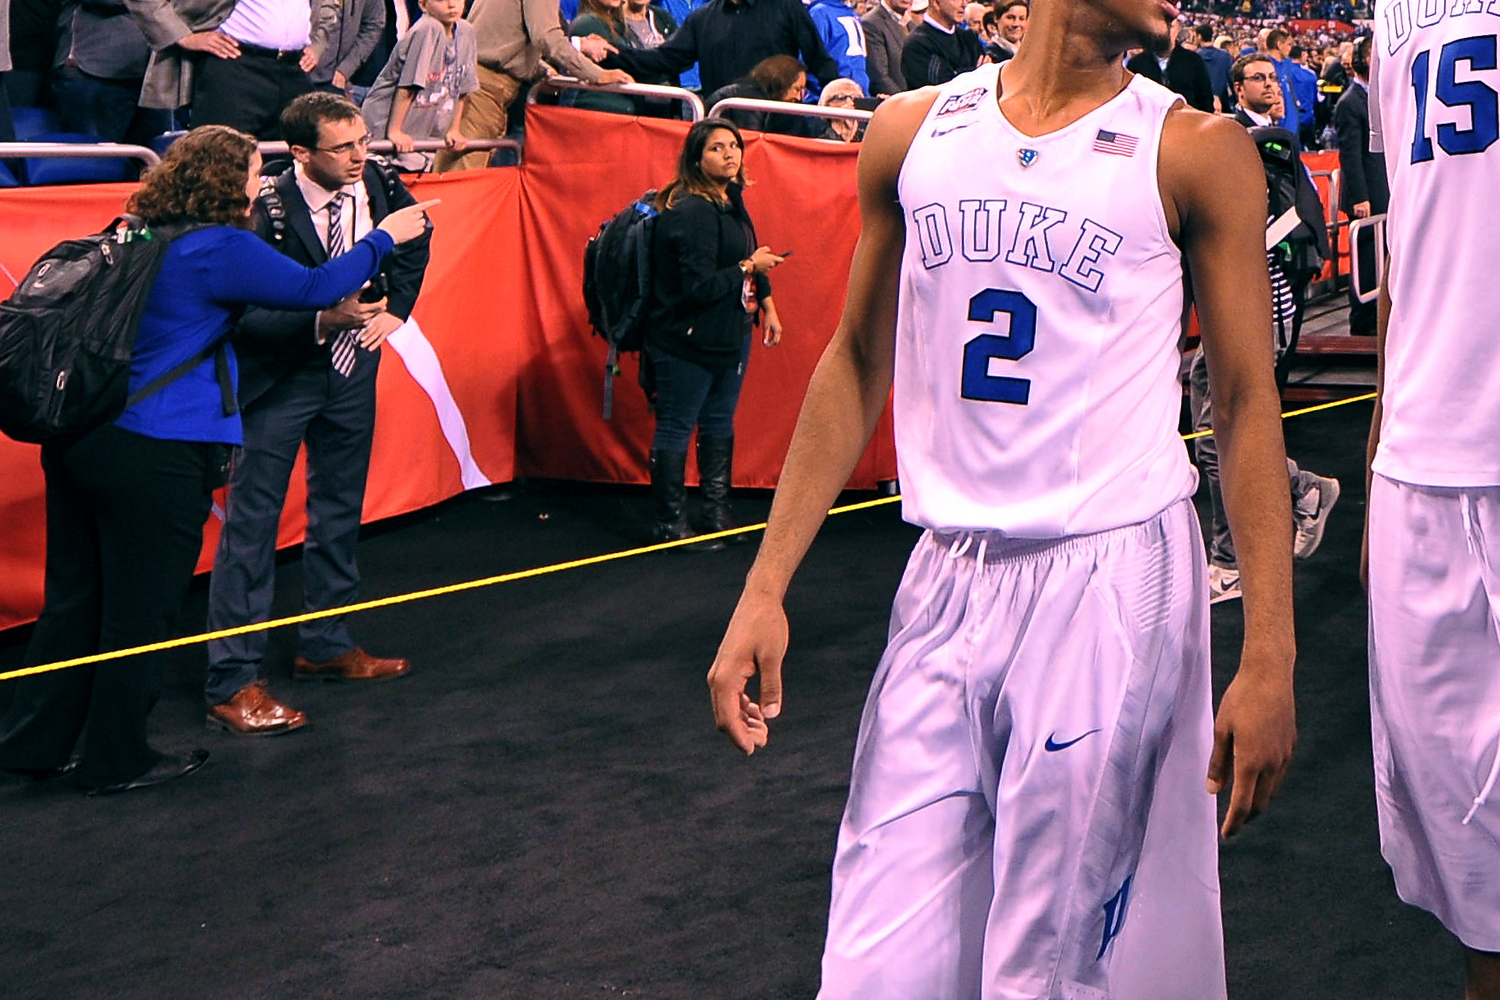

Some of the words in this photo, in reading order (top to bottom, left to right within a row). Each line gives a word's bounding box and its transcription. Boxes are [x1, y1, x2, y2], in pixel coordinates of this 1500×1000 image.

[1410, 34, 1500, 165] 15
[913, 199, 1124, 293] DUKE
[961, 287, 1037, 406] 2
